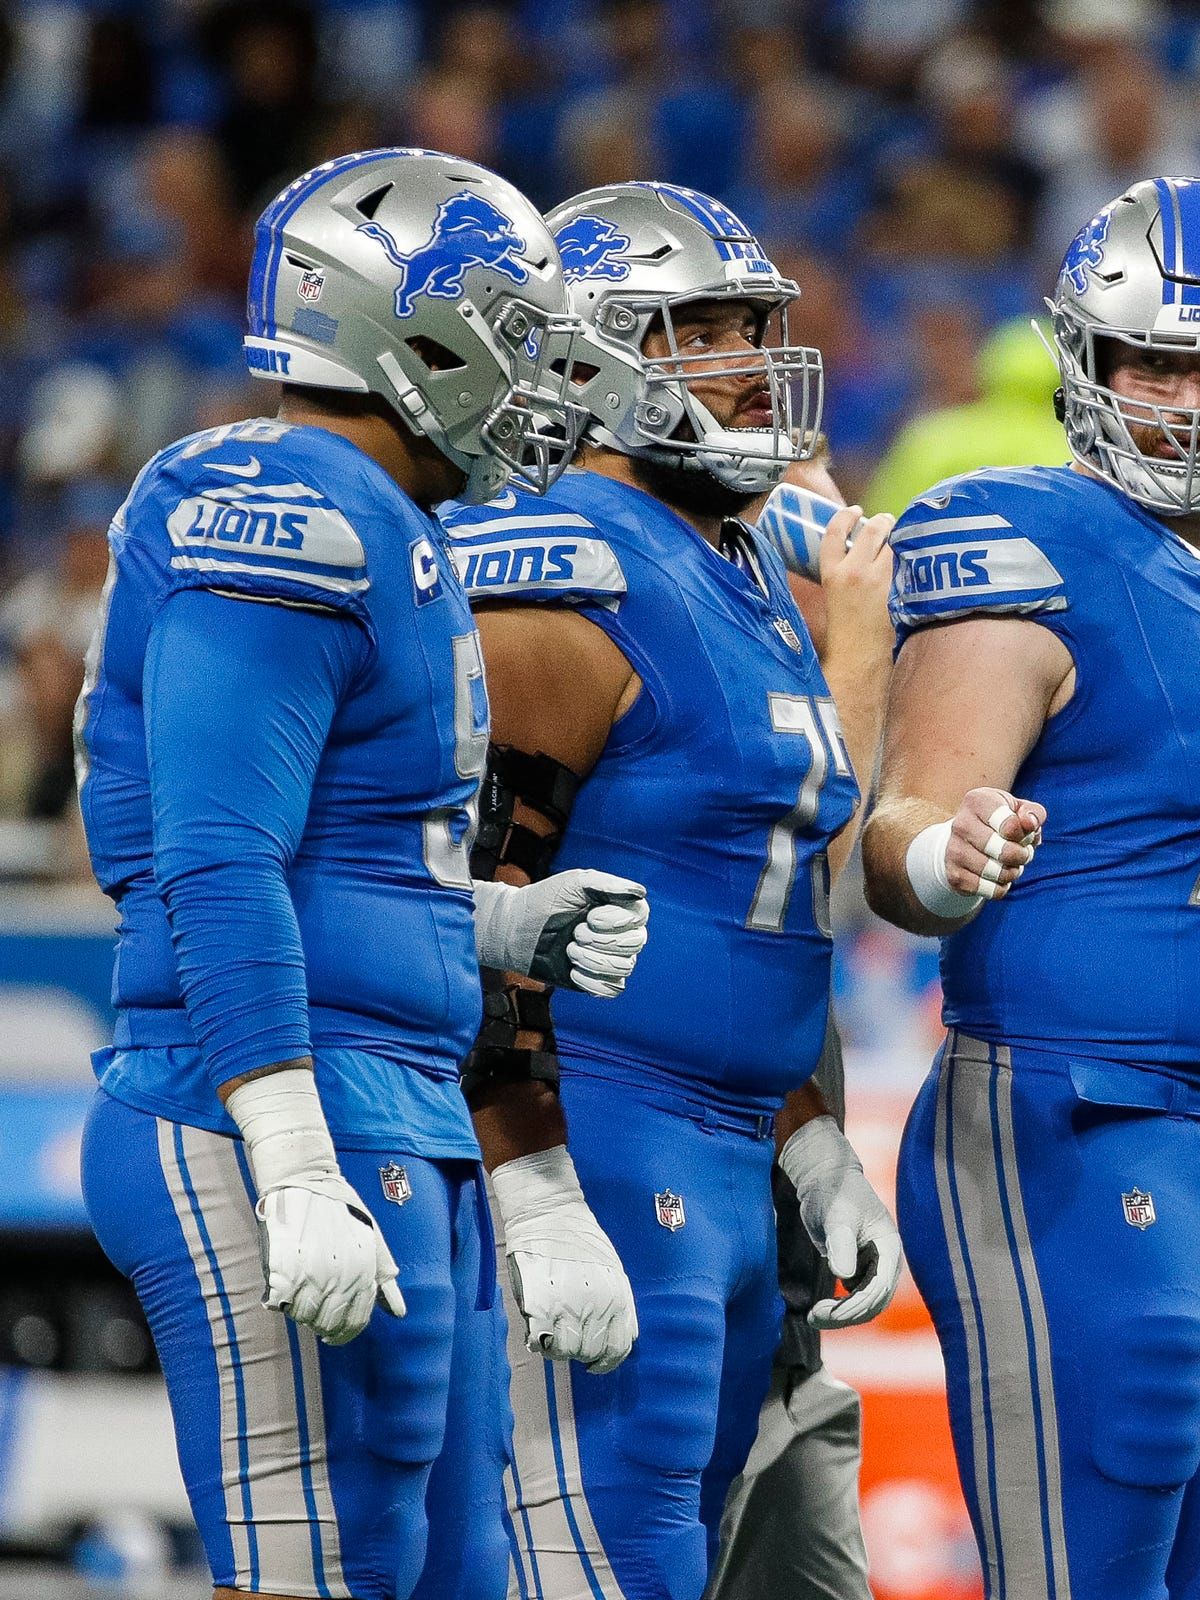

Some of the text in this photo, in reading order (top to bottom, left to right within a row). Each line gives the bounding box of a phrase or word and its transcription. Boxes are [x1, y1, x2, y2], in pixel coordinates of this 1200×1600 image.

[300, 281, 319, 298] NFL
[185, 504, 308, 551] LIONS
[412, 540, 438, 591] C
[463, 544, 578, 589] IONS
[386, 1181, 407, 1198] NFL
[661, 1208, 681, 1224] NFL
[1129, 1207, 1151, 1222] NFL
